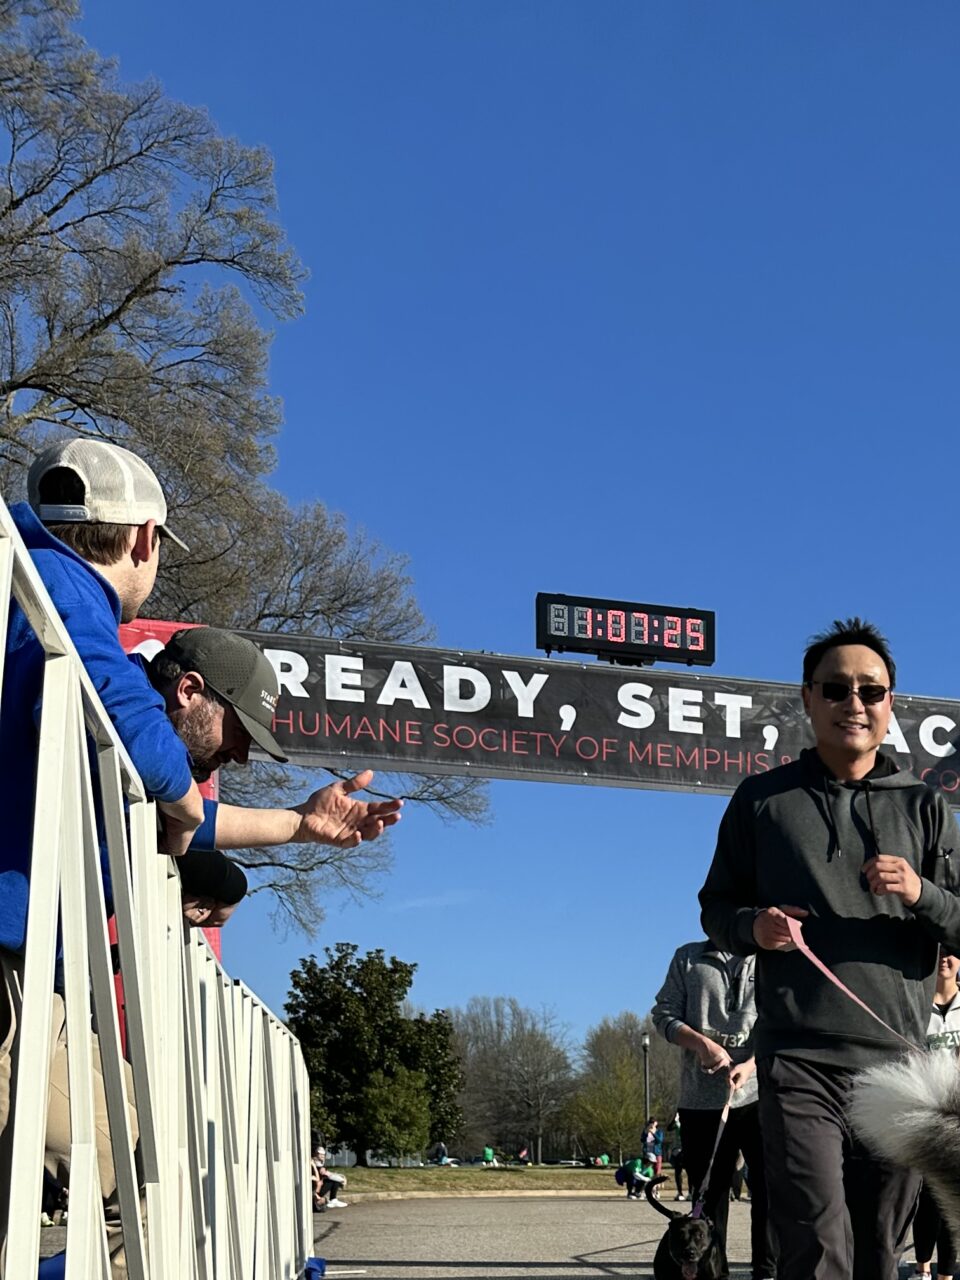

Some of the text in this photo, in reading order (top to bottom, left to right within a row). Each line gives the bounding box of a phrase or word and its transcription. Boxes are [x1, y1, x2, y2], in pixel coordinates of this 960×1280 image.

[263, 648, 577, 732] READY,
[617, 682, 780, 751] SET,
[272, 709, 424, 746] HUMANE
[433, 723, 567, 758] SOCIETY
[576, 736, 619, 762] OF
[628, 740, 771, 775] MEMPHIS
